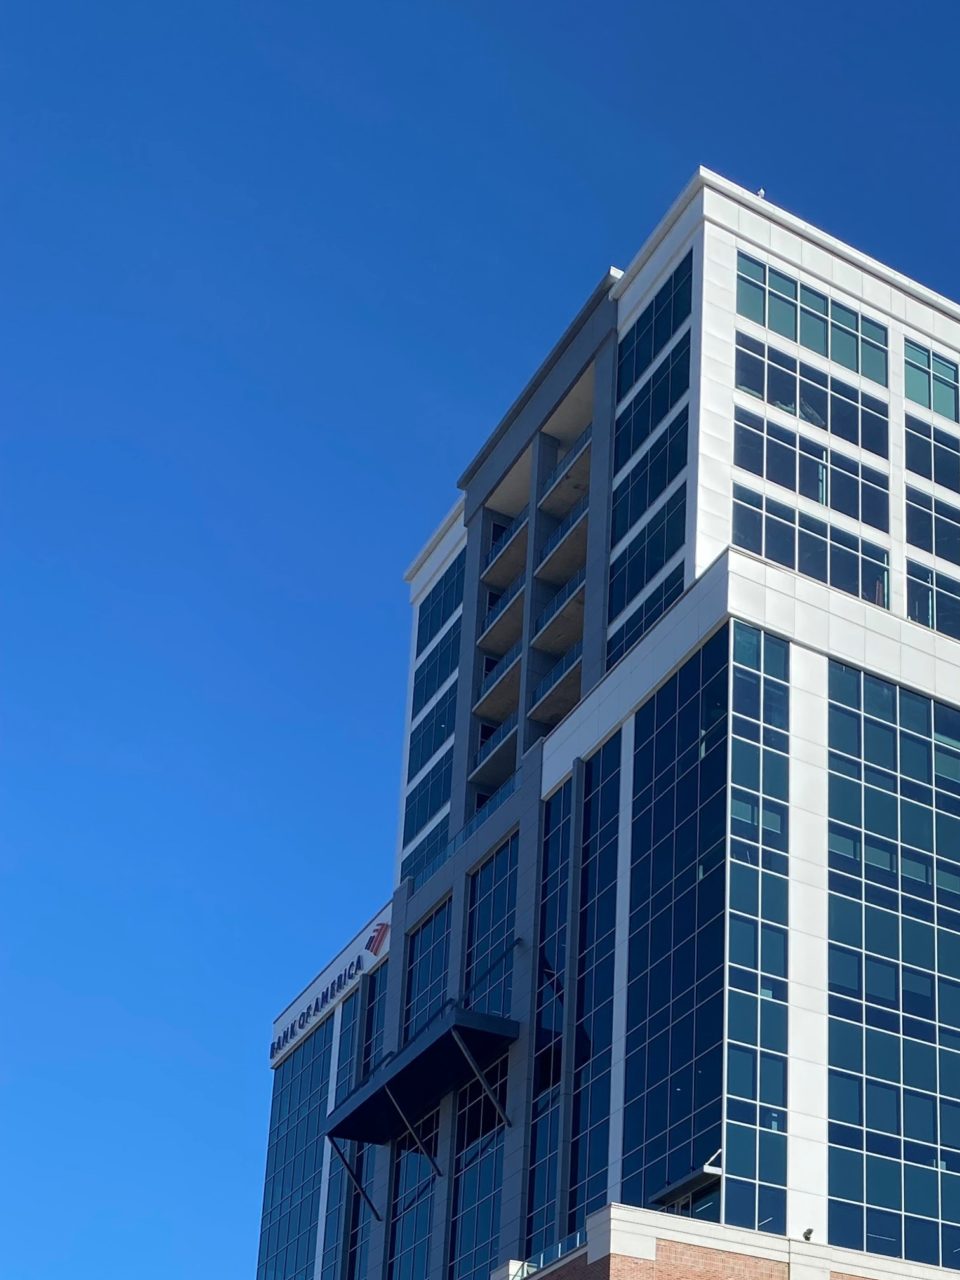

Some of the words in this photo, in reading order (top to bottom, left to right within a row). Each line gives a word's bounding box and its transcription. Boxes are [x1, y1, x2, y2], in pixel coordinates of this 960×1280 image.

[270, 1019, 297, 1060] BANK
[298, 1004, 313, 1029] OF
[313, 954, 363, 1017] AMERICA
